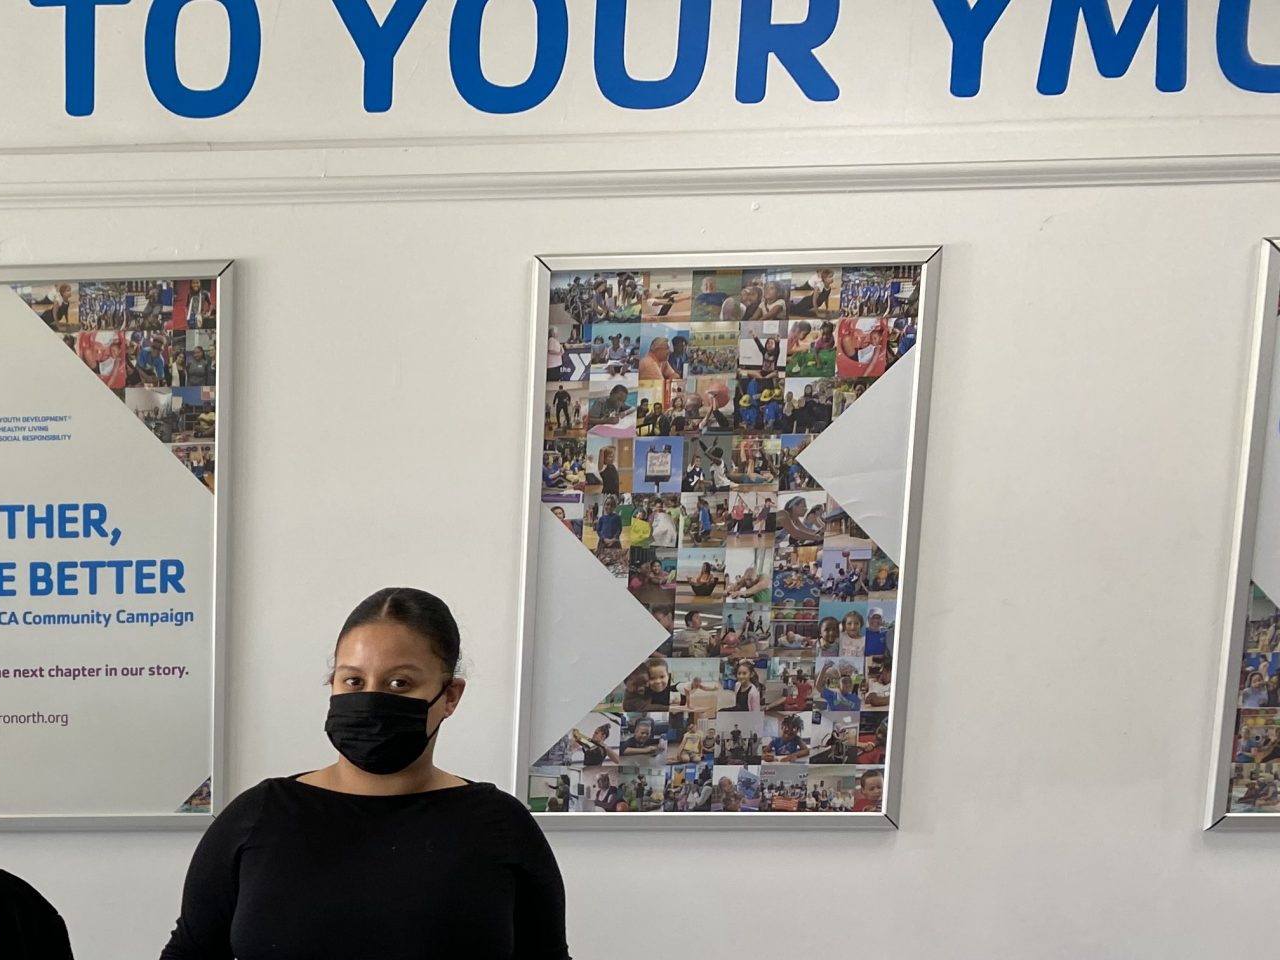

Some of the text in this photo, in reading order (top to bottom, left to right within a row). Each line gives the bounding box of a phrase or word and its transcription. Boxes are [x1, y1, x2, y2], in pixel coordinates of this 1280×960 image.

[30, 0, 261, 118] TO
[335, 0, 840, 113] YOUR
[22, 434, 71, 442] RESPONSIBILITY
[29, 559, 187, 597] BETTER
[23, 610, 111, 627] Community
[116, 608, 194, 625] Campaign
[13, 667, 45, 678] next
[48, 666, 103, 680] chapter
[105, 665, 118, 678] in
[121, 667, 145, 677] our
[148, 665, 189, 679] story.
